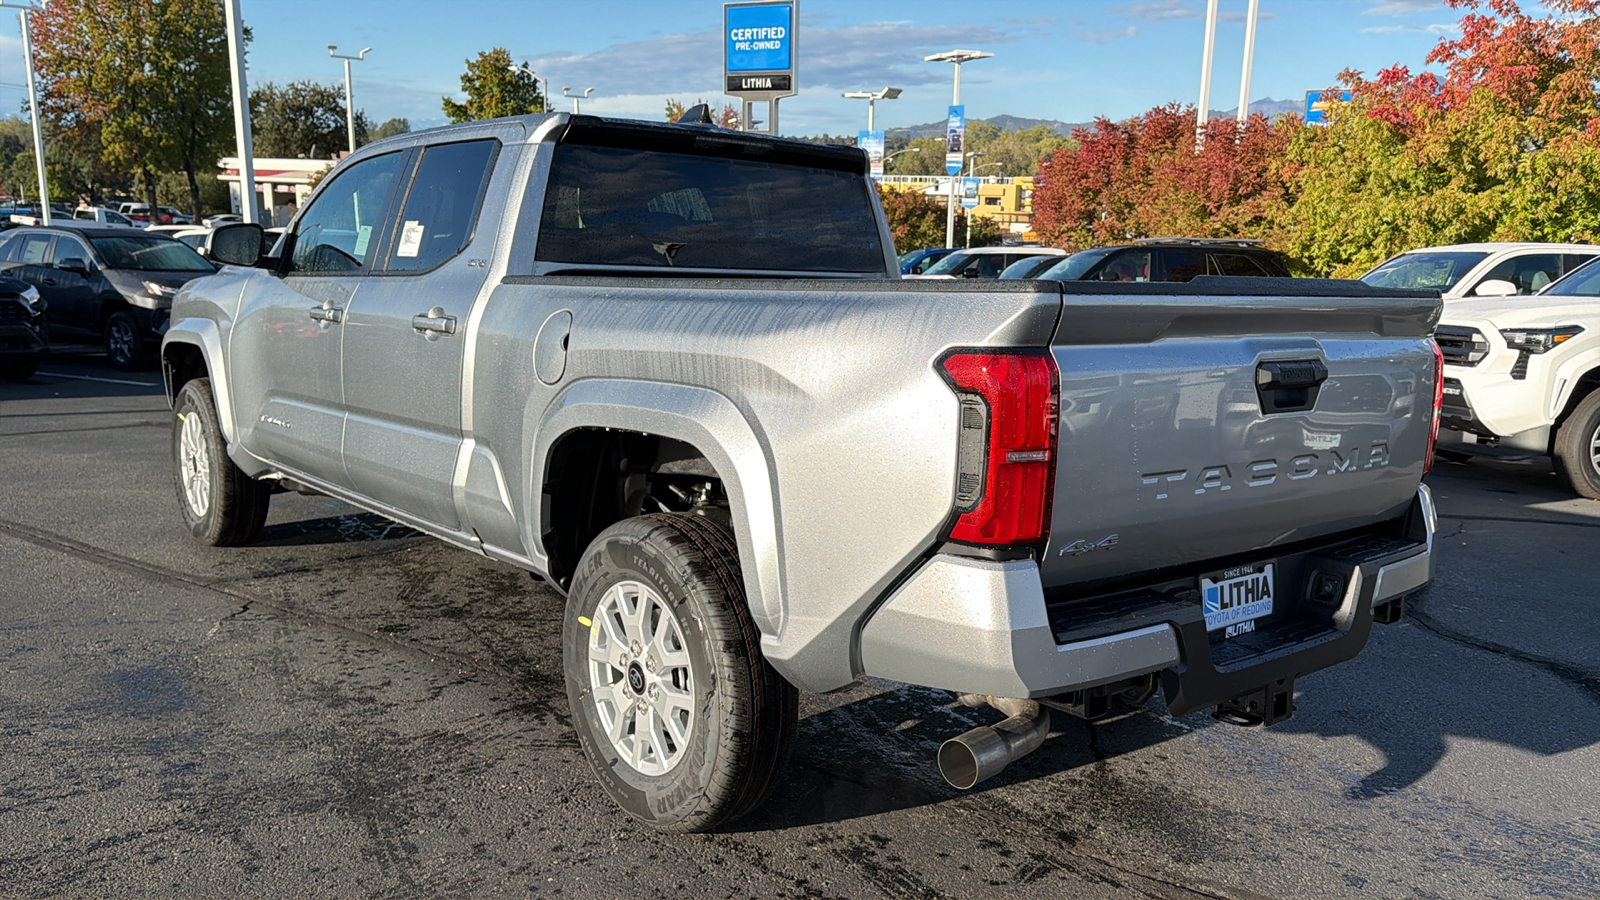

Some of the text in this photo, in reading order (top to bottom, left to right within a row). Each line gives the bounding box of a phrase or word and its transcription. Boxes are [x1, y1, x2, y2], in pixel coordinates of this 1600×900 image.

[730, 27, 785, 40] CERTIFIED
[735, 40, 780, 50] PRE-OWNED
[742, 78, 772, 88] LITHIA
[1141, 442, 1390, 499] TACOMA
[1224, 566, 1253, 578] SINCE 1946
[633, 556, 678, 608] TERRITORY
[1220, 576, 1271, 610] LITHIA
[1204, 600, 1272, 625] TOYOTA OF REDDING
[1232, 620, 1256, 637] LITHIA
